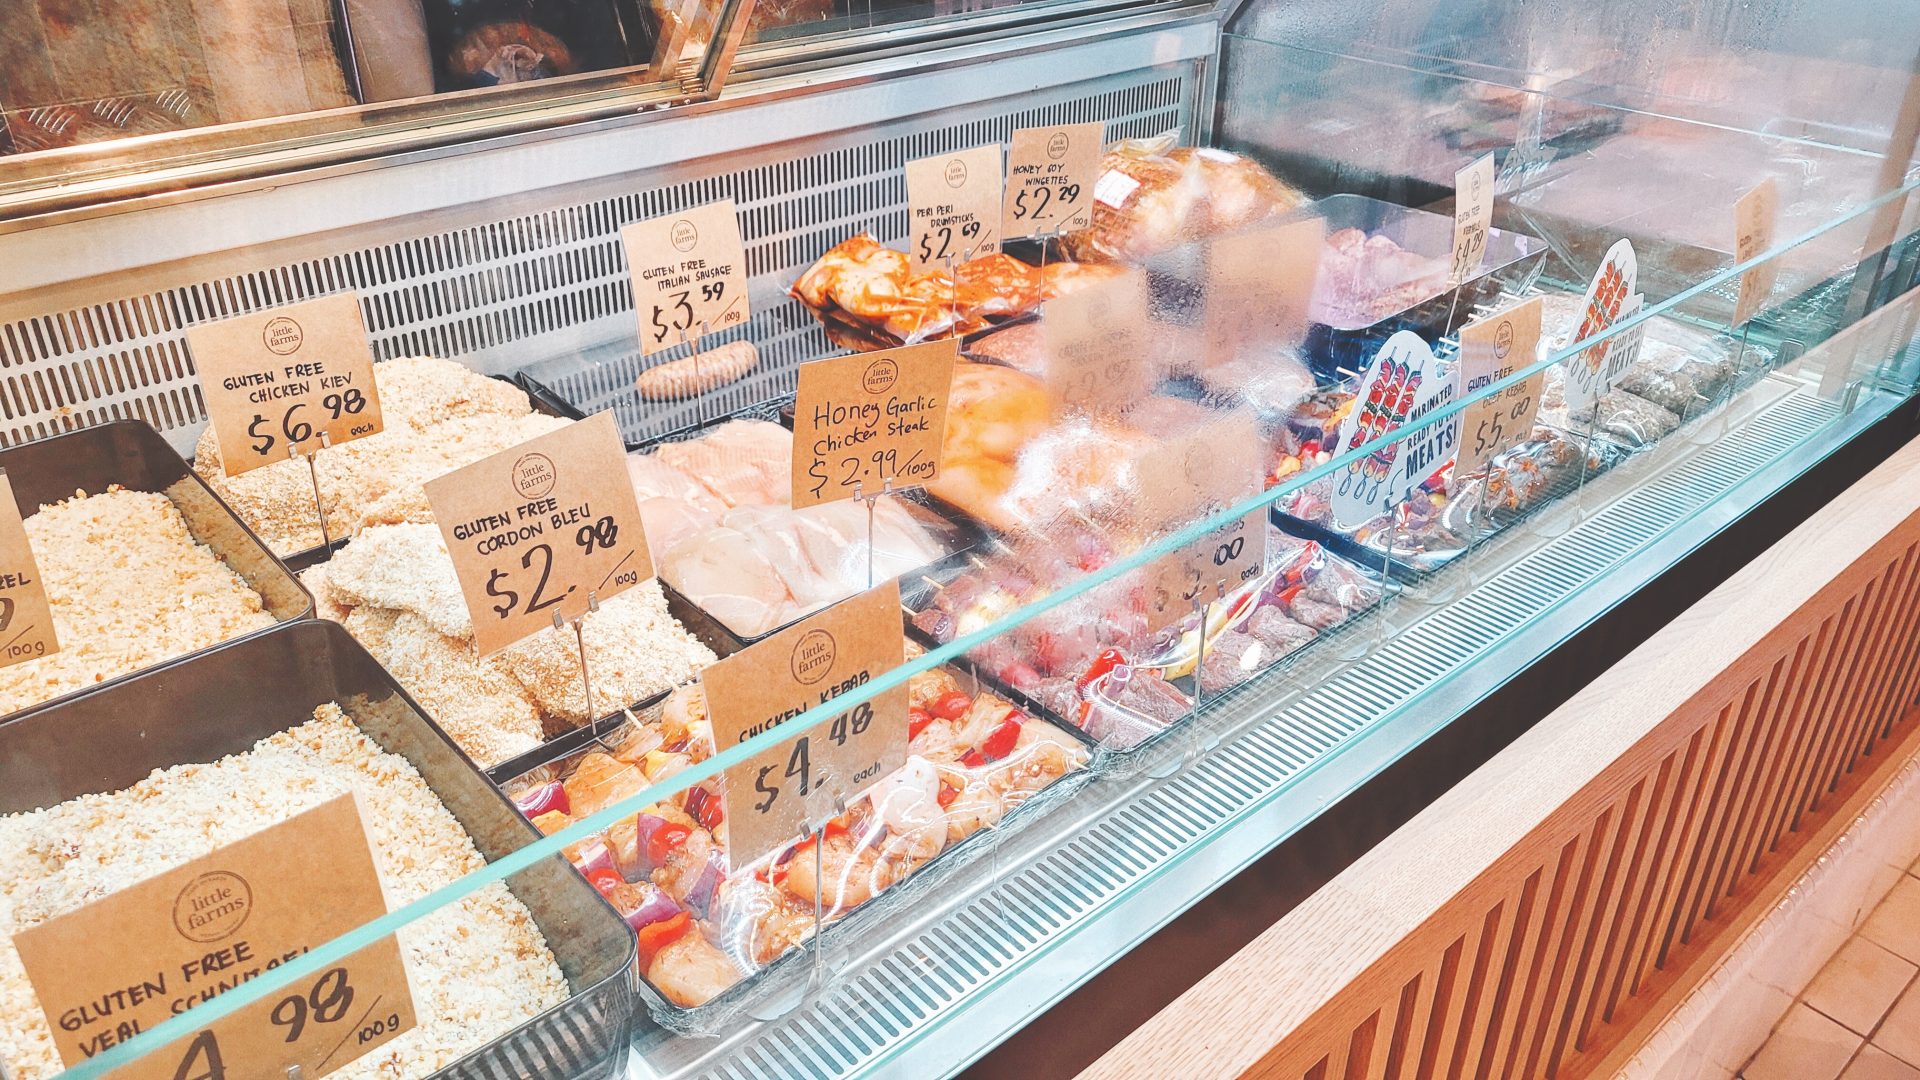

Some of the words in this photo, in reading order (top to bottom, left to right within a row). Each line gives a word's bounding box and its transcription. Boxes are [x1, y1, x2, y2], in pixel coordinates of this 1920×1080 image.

[1013, 164, 1043, 175] HONEY
[1025, 175, 1069, 186] WINGETTES
[916, 207, 933, 218] PERI
[936, 204, 954, 215] PERI
[930, 213, 974, 228] DRUMSTICKS
[642, 265, 675, 280] GLUTEN
[680, 259, 706, 271] FREE
[658, 274, 691, 292] ITALIAN
[695, 264, 732, 282] SAUSAGE
[270, 334, 299, 347] farms
[272, 326, 293, 337] little
[223, 371, 275, 391] GLUTEN
[285, 362, 325, 379] FREE
[867, 375, 893, 385] farms
[873, 367, 891, 377] little
[1467, 374, 1491, 392] GLUTEN
[249, 381, 310, 403] CHICKEN
[320, 372, 352, 389] KIEV
[813, 401, 880, 430] Honey
[886, 396, 937, 418] Garlic
[1411, 384, 1452, 422] MARINATED
[1407, 424, 1430, 451] READY
[1405, 420, 1457, 480] MEATS!
[520, 471, 552, 490] farms
[521, 464, 544, 479] little
[453, 511, 512, 541] GLUTEN
[517, 497, 558, 521] FREE
[477, 522, 543, 555] CORDON
[551, 503, 591, 529] BLEU
[799, 651, 831, 674] farms
[802, 642, 825, 660] little
[820, 670, 870, 704] KEBAB
[853, 761, 881, 784] each
[191, 888, 232, 912] little
[188, 898, 244, 929] farms
[59, 972, 166, 1032] GLUTEN
[181, 941, 255, 983] FREE
[78, 1019, 144, 1058] VEAL
